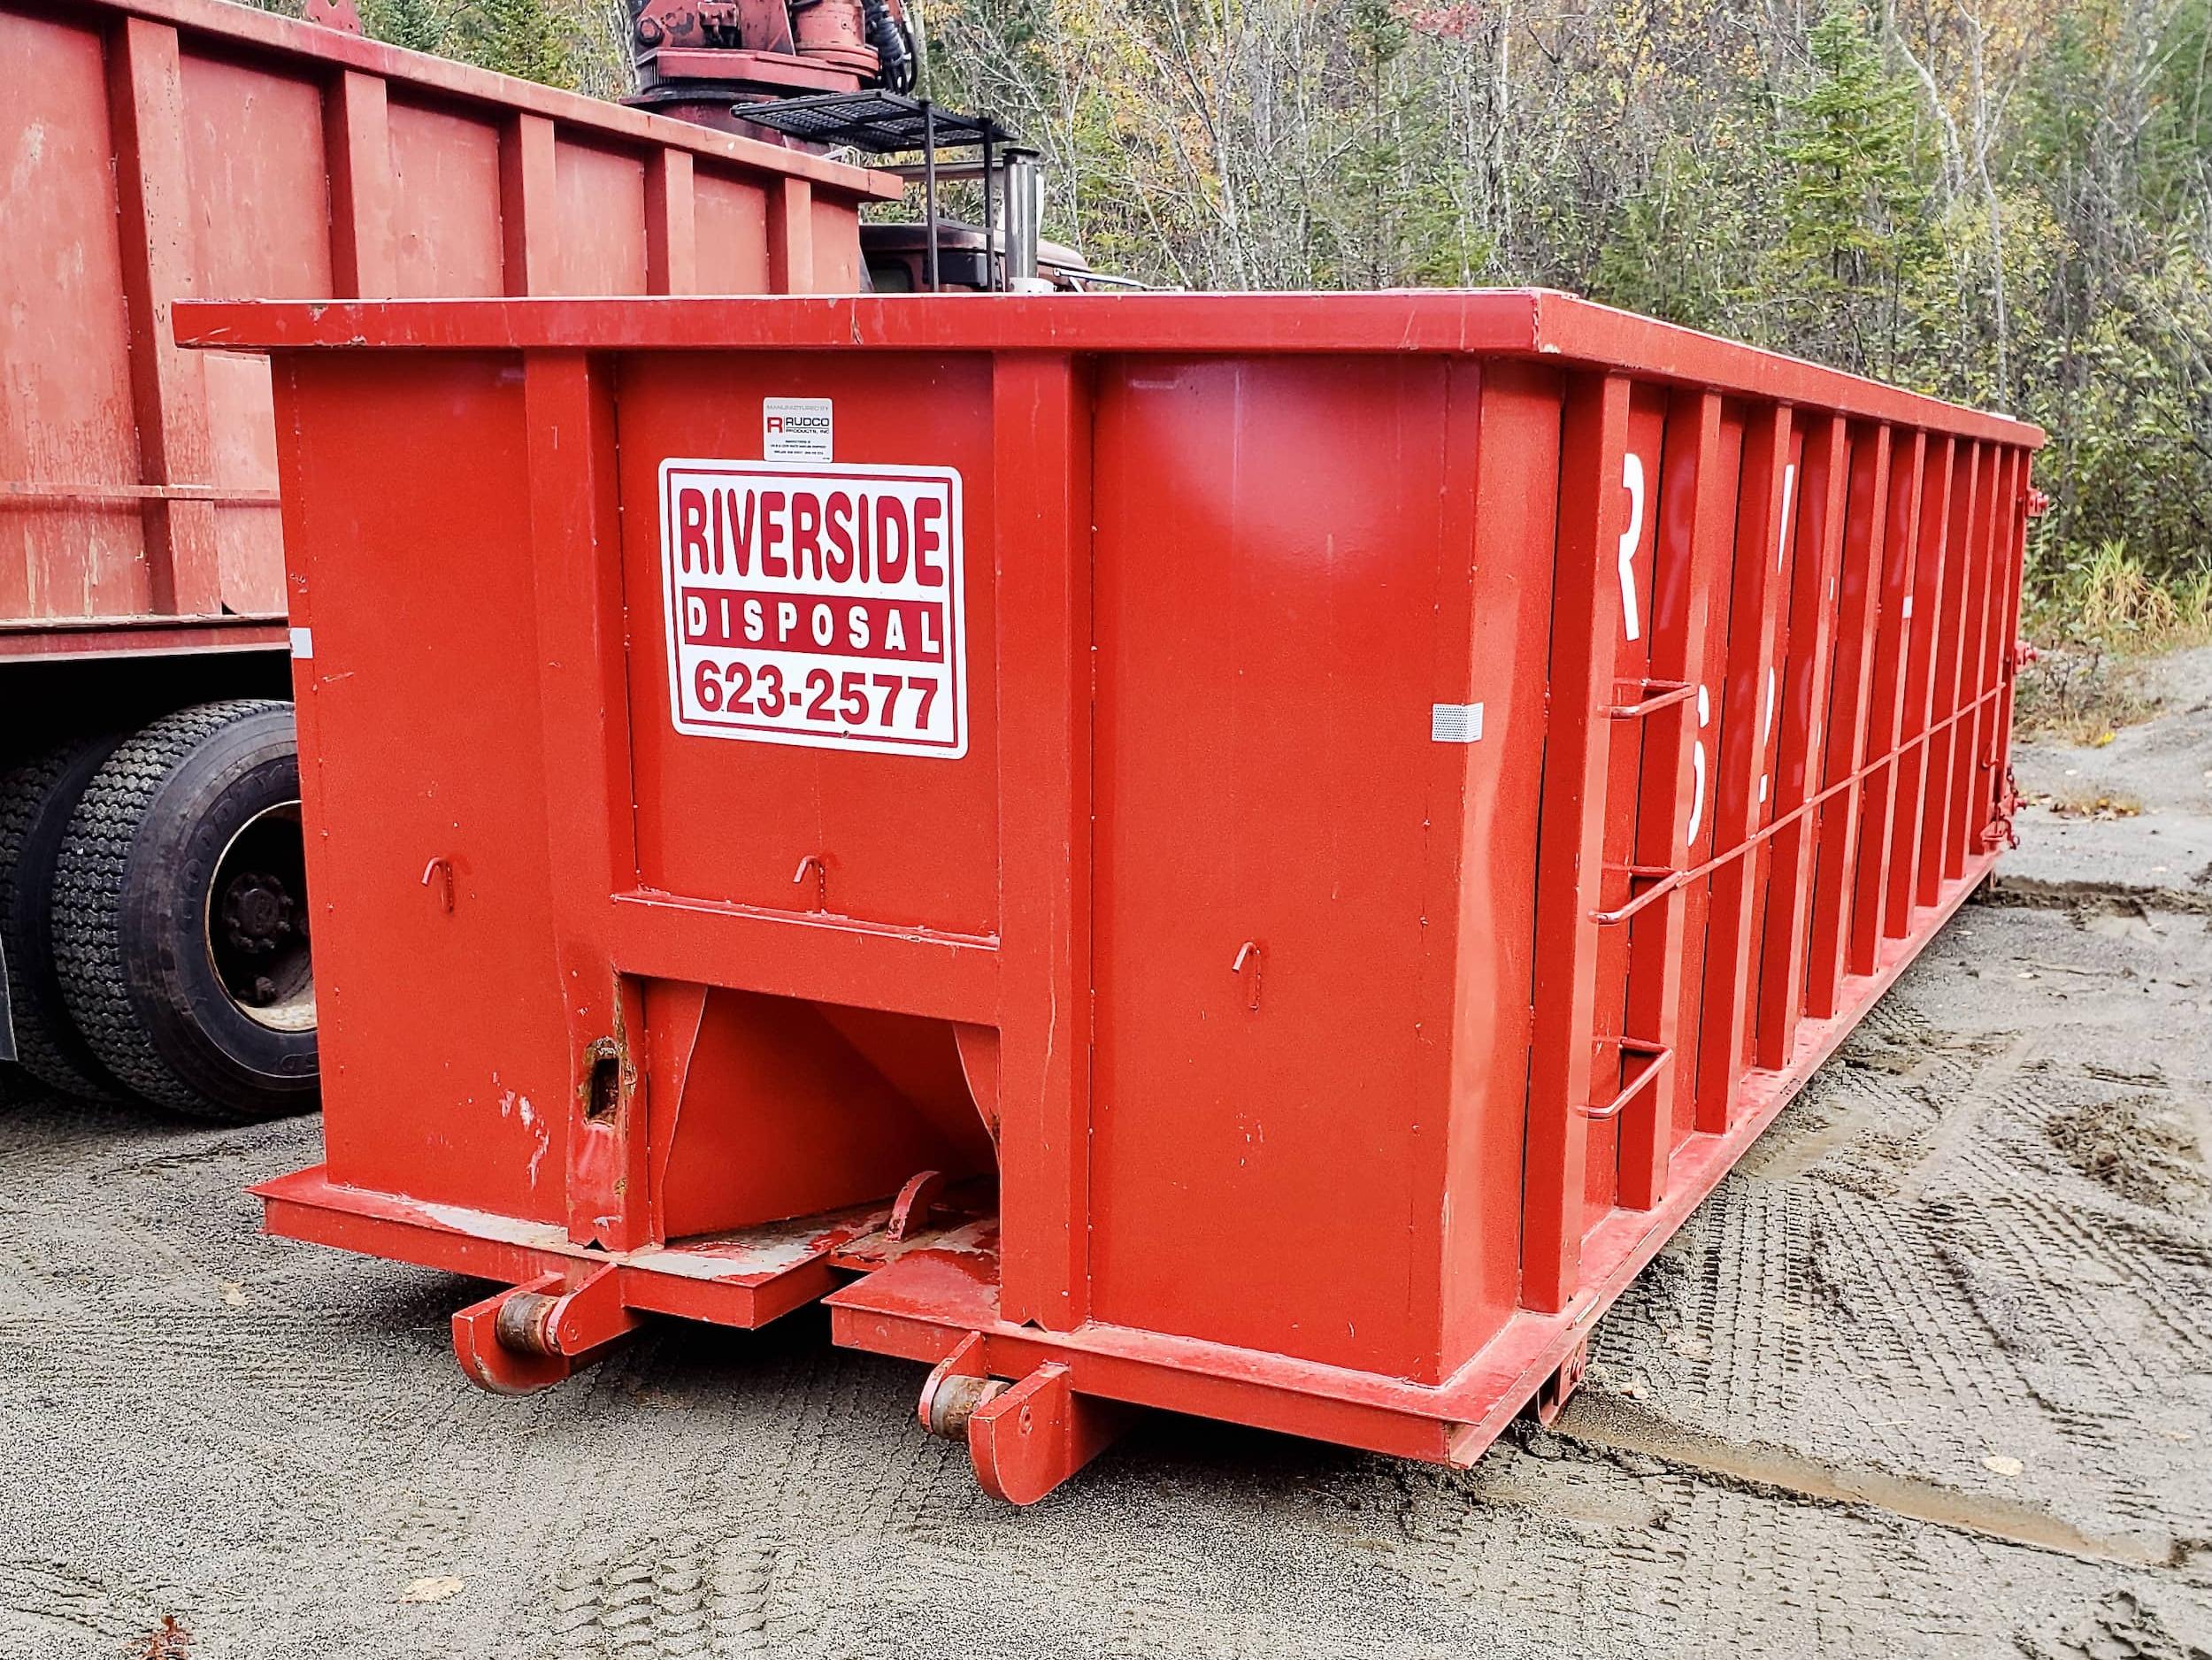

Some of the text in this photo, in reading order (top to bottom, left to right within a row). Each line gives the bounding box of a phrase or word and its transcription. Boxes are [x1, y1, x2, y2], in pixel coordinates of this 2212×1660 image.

[767, 417, 783, 434] R
[786, 417, 830, 427] RUDCO
[680, 488, 944, 587] RIVERSIDE
[687, 596, 941, 654] DISPOSAL
[695, 660, 939, 730] 623-2577
